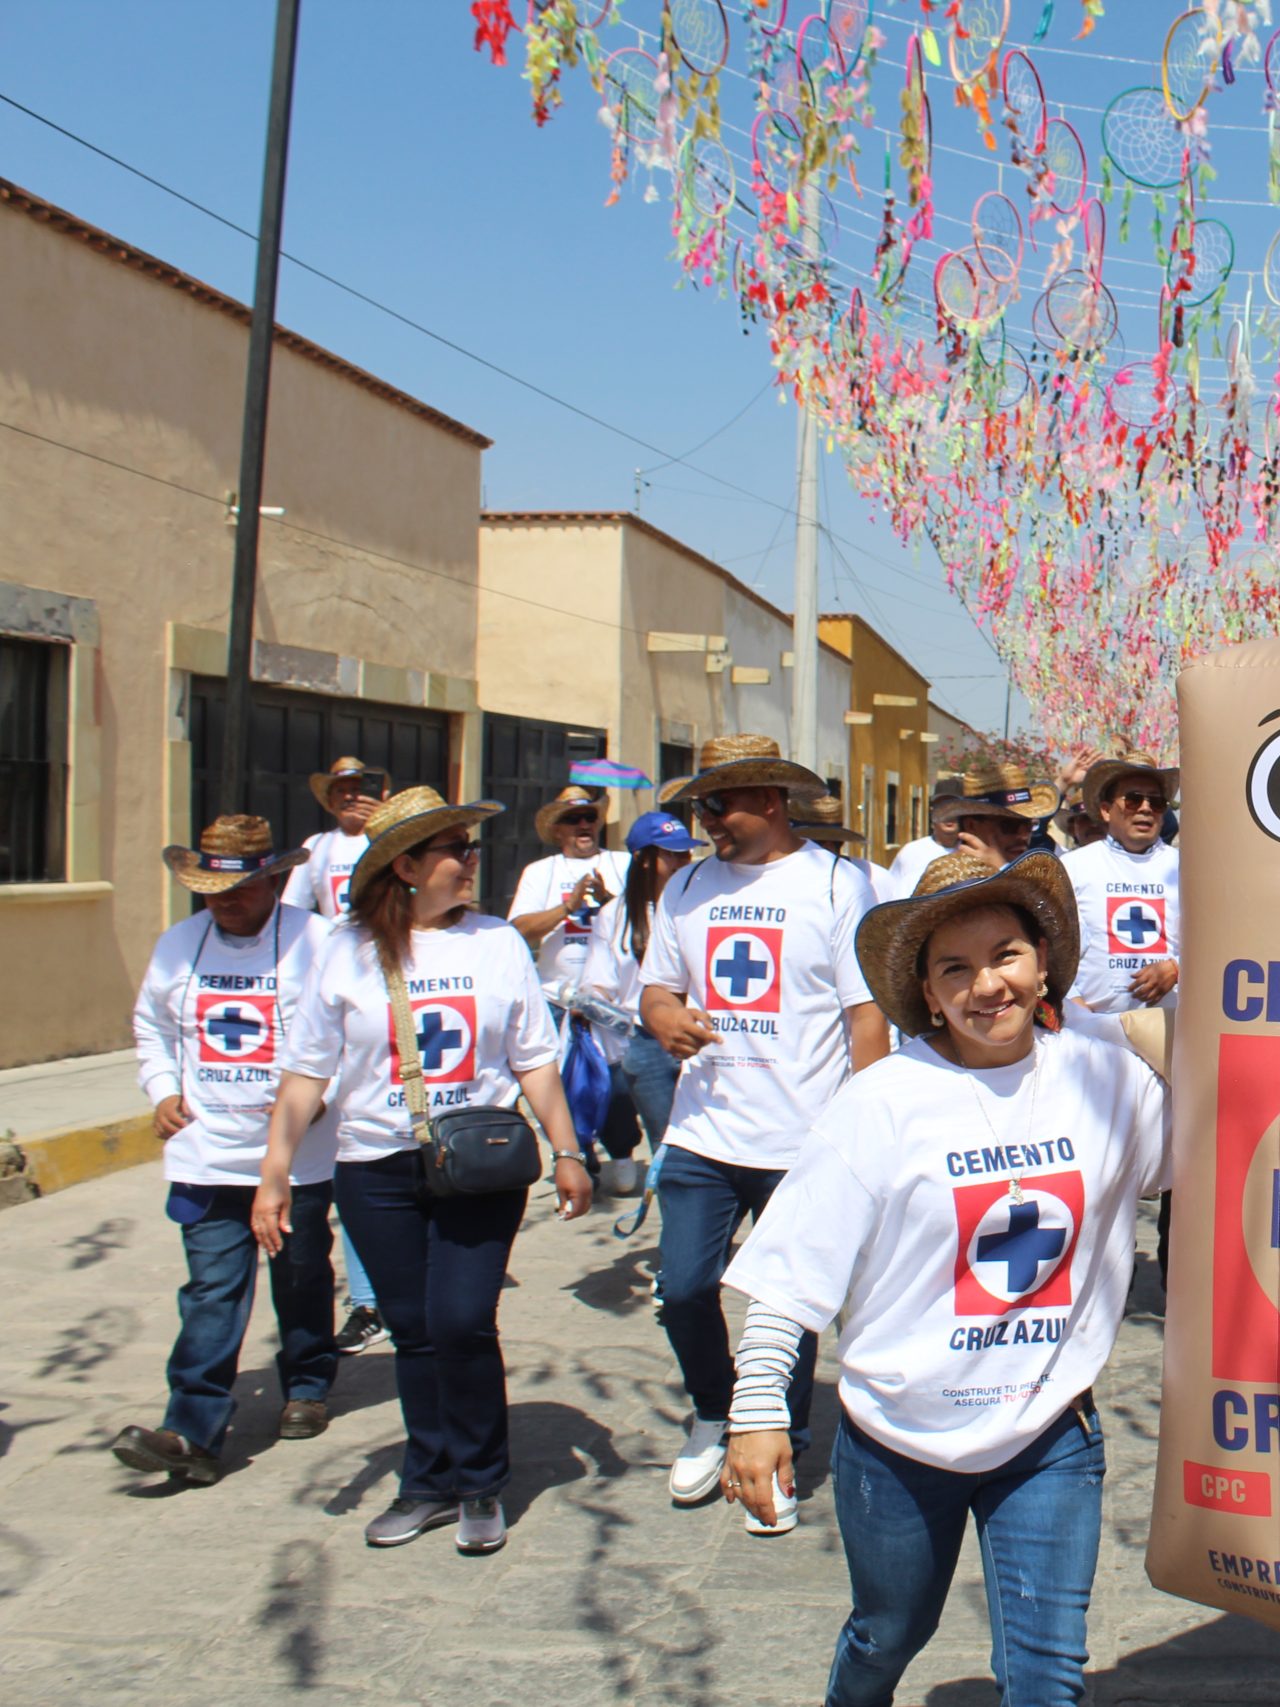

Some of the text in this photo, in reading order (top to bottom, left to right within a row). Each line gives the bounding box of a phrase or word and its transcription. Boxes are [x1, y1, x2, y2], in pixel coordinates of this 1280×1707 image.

[1106, 883, 1165, 895] CEMENTO
[709, 906, 786, 923] CEMENTO
[1108, 958, 1139, 969] CRUZ
[199, 975, 277, 990] CEMENTO
[405, 976, 474, 994] MENTO
[712, 1017, 779, 1035] RUZ AZUL
[199, 1068, 273, 1083] CRUZ AZUL
[433, 1087, 471, 1107] AZUL
[946, 1136, 1075, 1176] CEMENTO
[949, 1321, 1009, 1351] CRUZ
[942, 1386, 1002, 1398] CONSTRUYE
[1004, 1384, 1018, 1394] TU
[954, 1396, 1002, 1408] ASEGURA
[1004, 1394, 1018, 1404] TU
[1201, 1473, 1246, 1503] CPC
